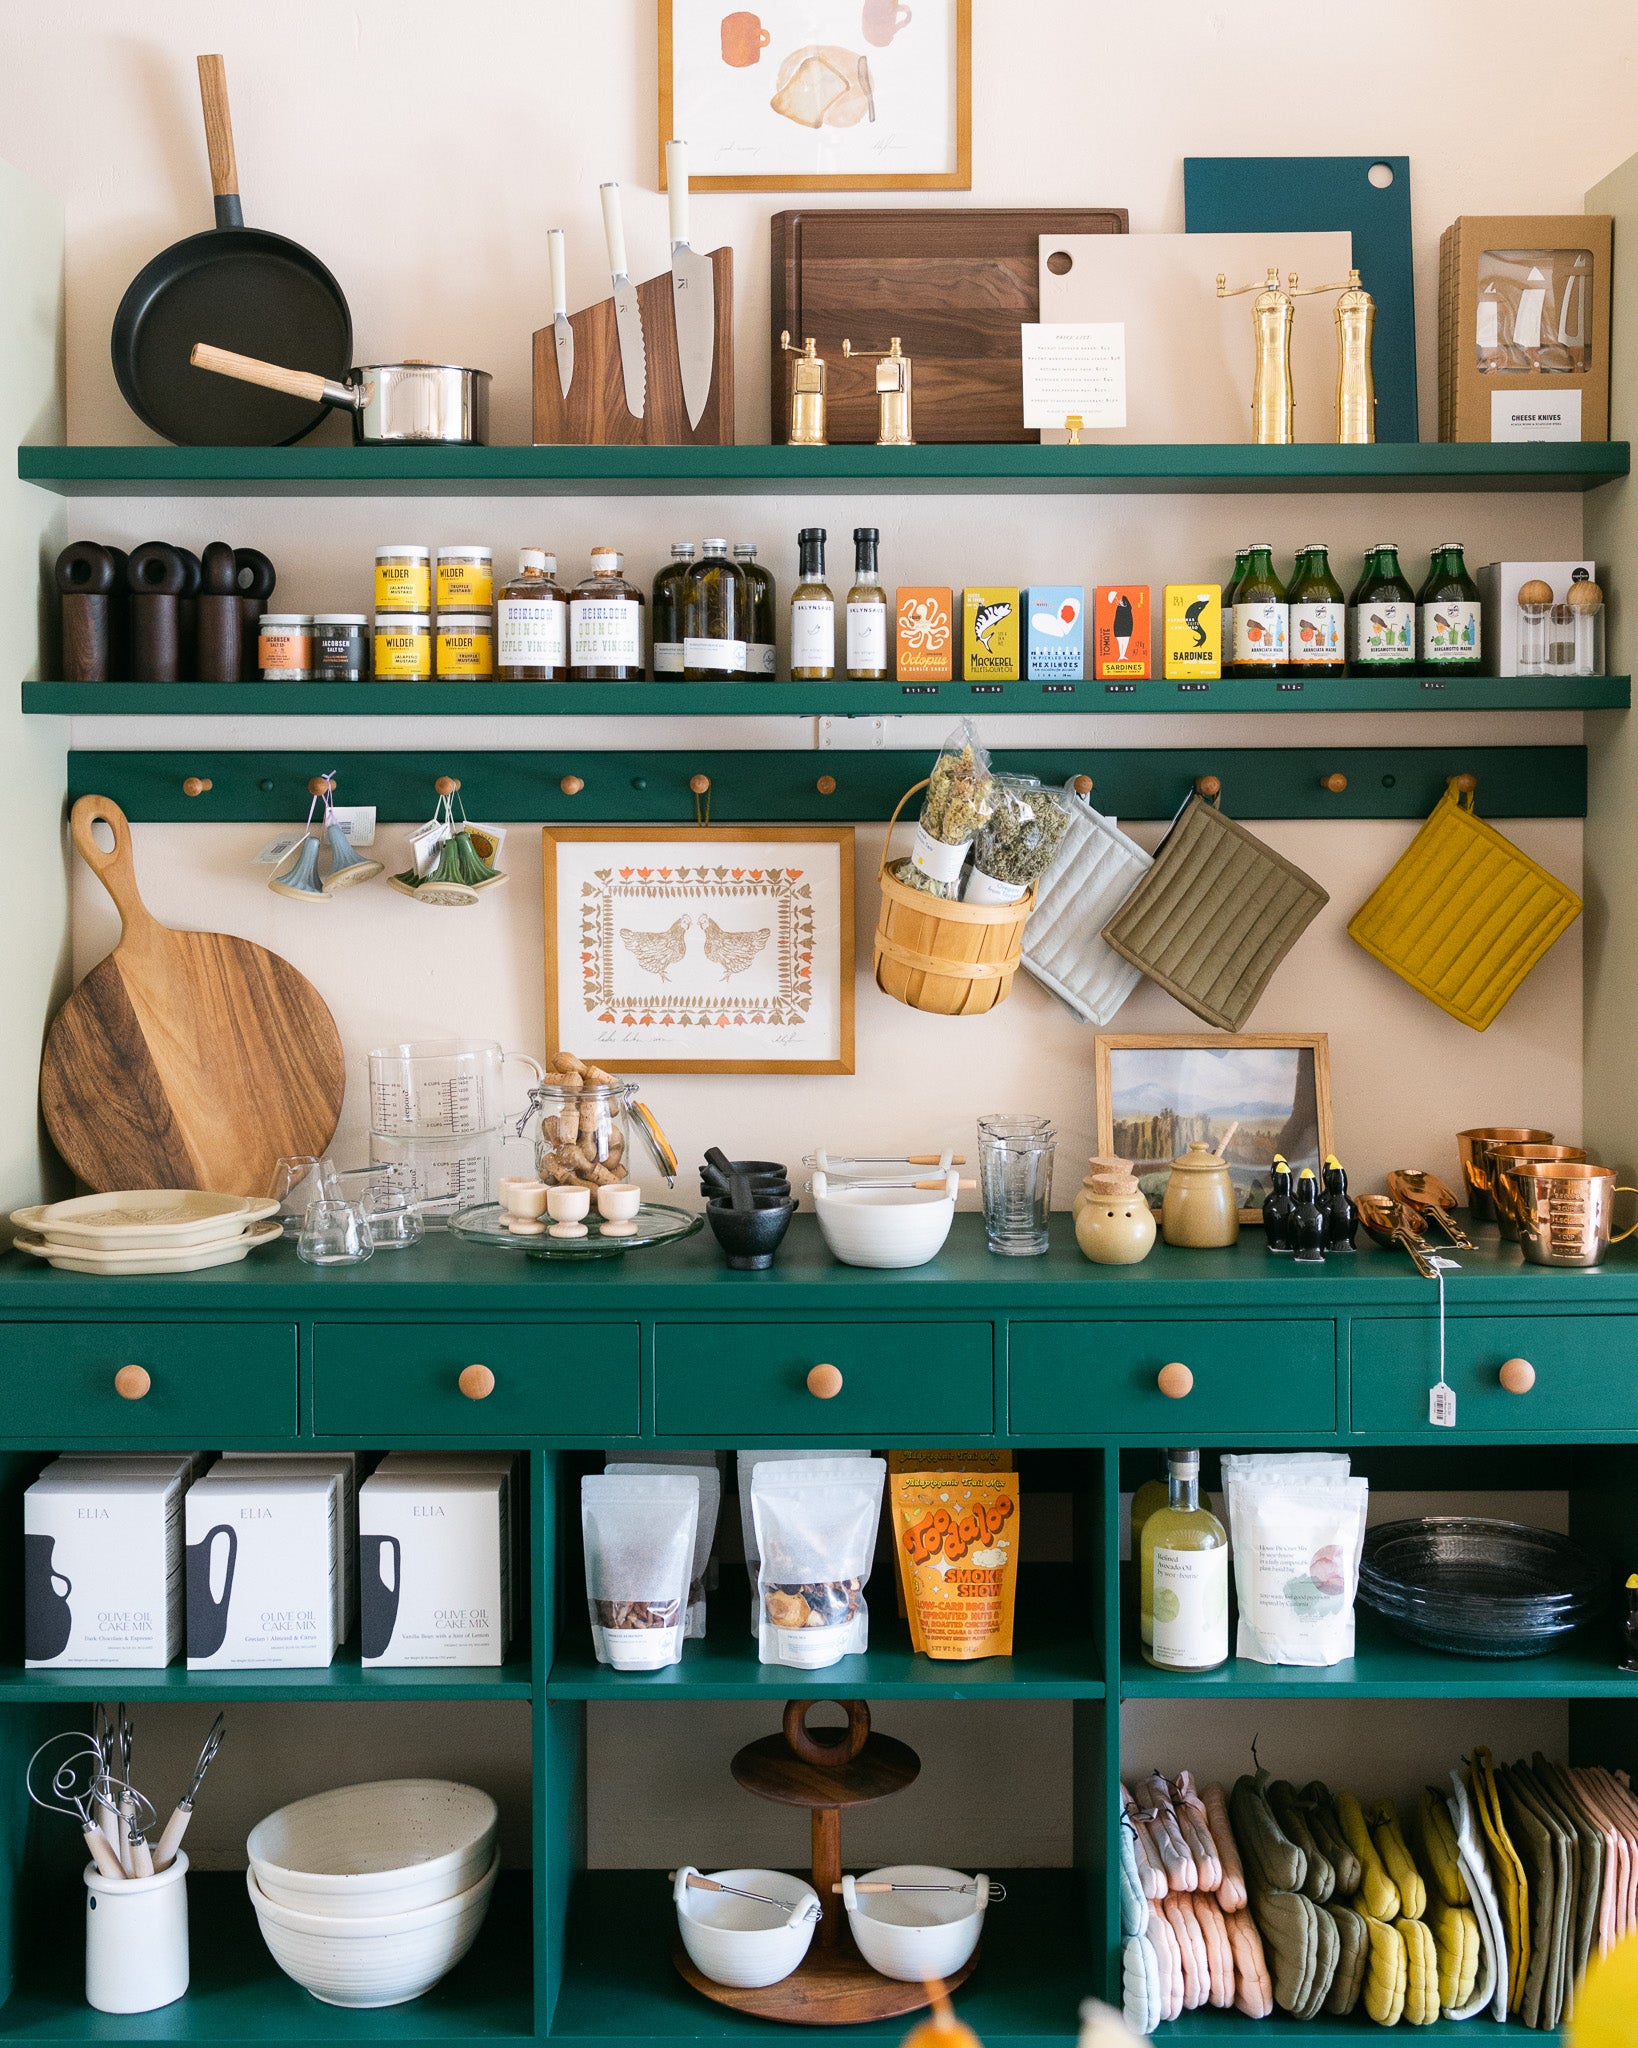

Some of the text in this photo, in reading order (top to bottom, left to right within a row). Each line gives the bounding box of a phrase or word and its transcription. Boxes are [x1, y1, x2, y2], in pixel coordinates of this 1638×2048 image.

[381, 569, 409, 578] WILDER
[440, 568, 464, 577] WILDER
[508, 608, 553, 620] HEIRLOOM
[582, 608, 627, 620] HEIRLOOM
[386, 638, 414, 647] WILDER
[445, 638, 473, 647] WILDER
[900, 651, 948, 667] Octopus
[971, 654, 1013, 667] MACKEREL
[1173, 652, 1213, 661] SARDINES
[902, 1478, 959, 1490] Adaptogenic
[986, 1480, 1006, 1491] Mix
[78, 1508, 110, 1519] ELIA
[240, 1507, 273, 1519] ELIA
[413, 1506, 445, 1517] ELIA
[902, 1494, 1014, 1566] Toodaloo
[1157, 1553, 1179, 1562] Refined
[944, 1569, 1003, 1583] SMOKE
[957, 1584, 1003, 1597] SHOW
[97, 1612, 152, 1621] OLIVE OIL
[261, 1611, 315, 1622] OLIVE OIL
[434, 1609, 489, 1619] OLIVE OIL
[923, 1611, 968, 1620] SPROUTED
[98, 1622, 153, 1631] CAKE MIX
[262, 1621, 317, 1631] CAKE MIX
[435, 1619, 489, 1629] CAKE MIX
